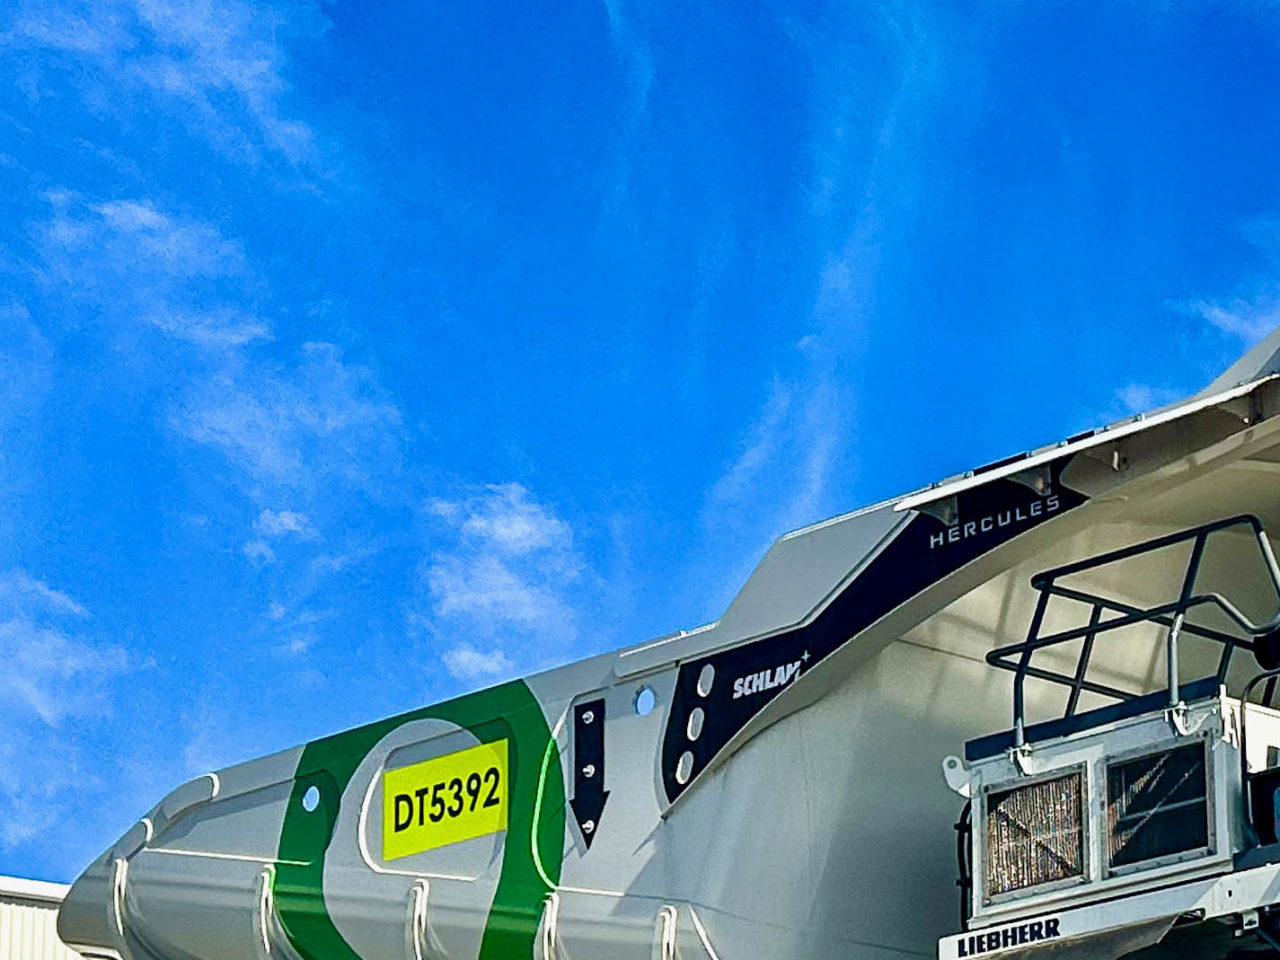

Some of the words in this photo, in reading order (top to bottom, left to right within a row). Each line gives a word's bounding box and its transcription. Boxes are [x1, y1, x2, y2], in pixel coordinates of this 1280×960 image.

[929, 495, 1060, 549] HERCULES
[394, 766, 500, 833] DT5392
[958, 918, 1061, 958] LIEBHERR
